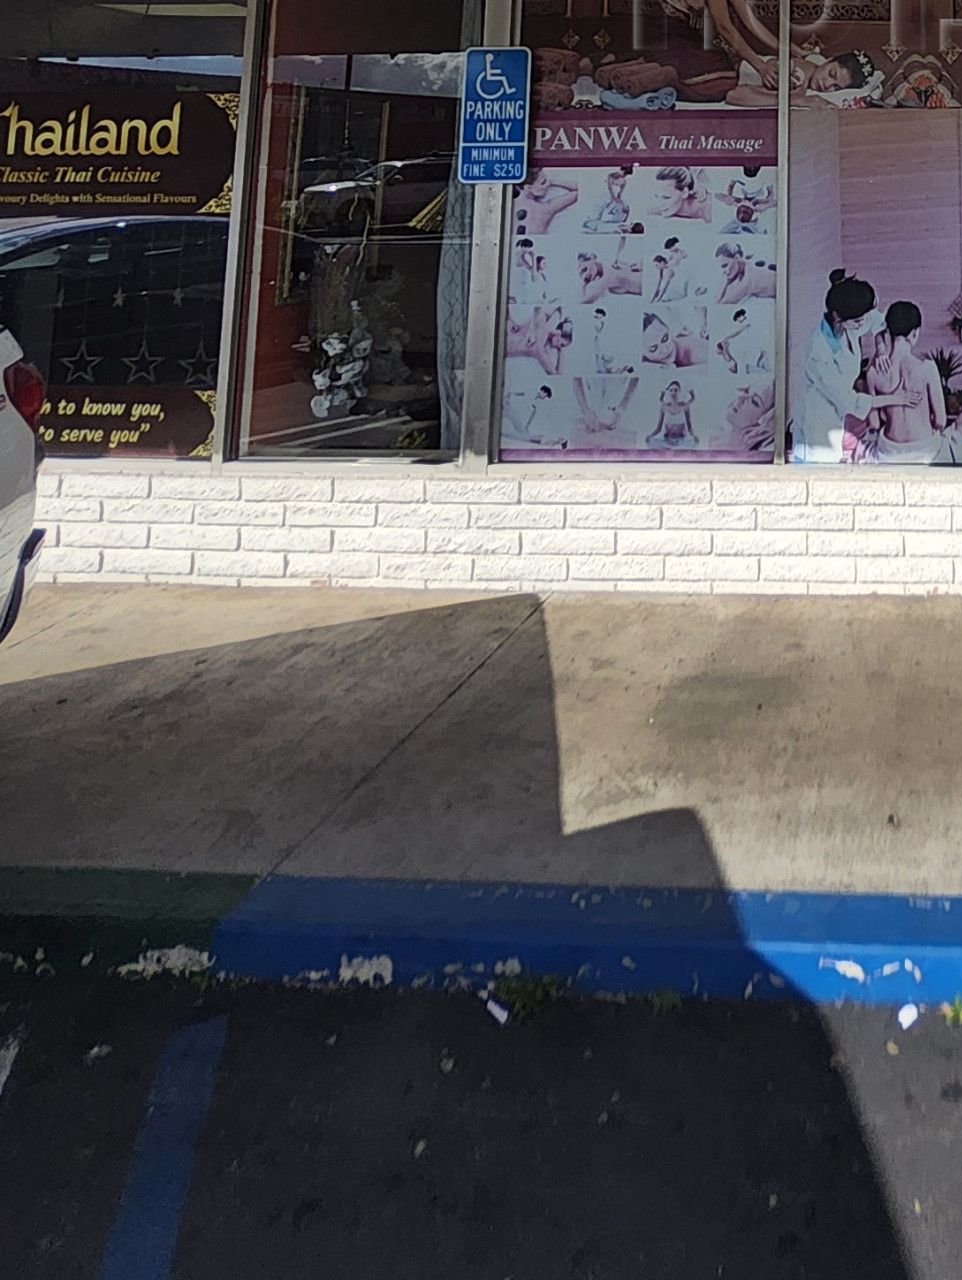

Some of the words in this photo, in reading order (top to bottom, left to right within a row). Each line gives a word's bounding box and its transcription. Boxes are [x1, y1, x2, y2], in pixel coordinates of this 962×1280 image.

[465, 100, 524, 120] PARKING
[475, 121, 513, 141] ONLY
[533, 126, 647, 151] PANWA
[659, 134, 694, 150] Thai
[696, 135, 764, 153] Massage
[470, 147, 515, 160] MINIMUM
[54, 166, 92, 183] Thai
[97, 166, 160, 184] Cuisine
[462, 163, 486, 177] FINE
[493, 163, 522, 177] $250
[30, 193, 69, 205] Delights
[72, 194, 93, 204] with
[95, 193, 151, 204] Sensational
[153, 193, 197, 204] Flavours
[57, 399, 75, 415] to
[81, 397, 126, 416] know
[130, 402, 165, 421] you,
[60, 429, 104, 442] serve
